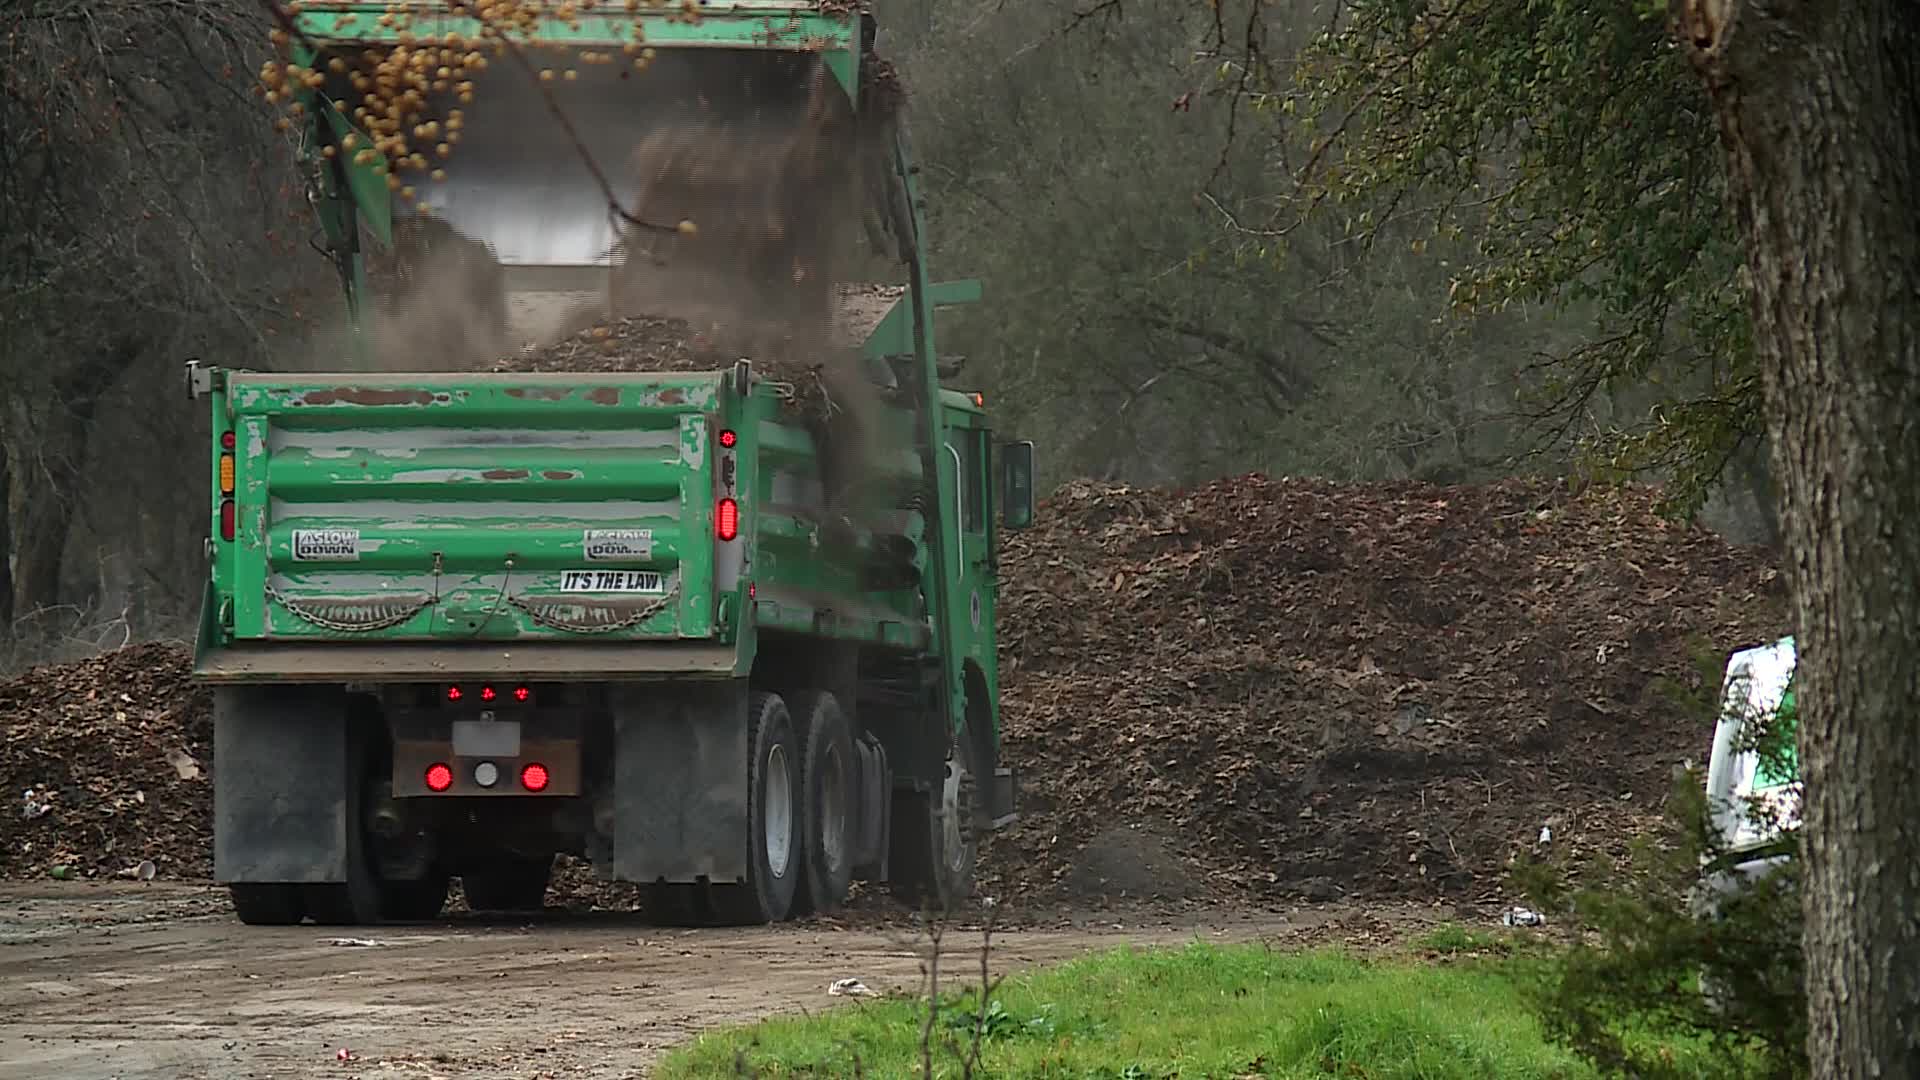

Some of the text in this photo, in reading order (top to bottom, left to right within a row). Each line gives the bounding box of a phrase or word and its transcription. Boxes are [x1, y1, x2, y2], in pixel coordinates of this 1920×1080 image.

[300, 545, 354, 554] DOWN
[564, 572, 658, 590] IT'S THE LAW
